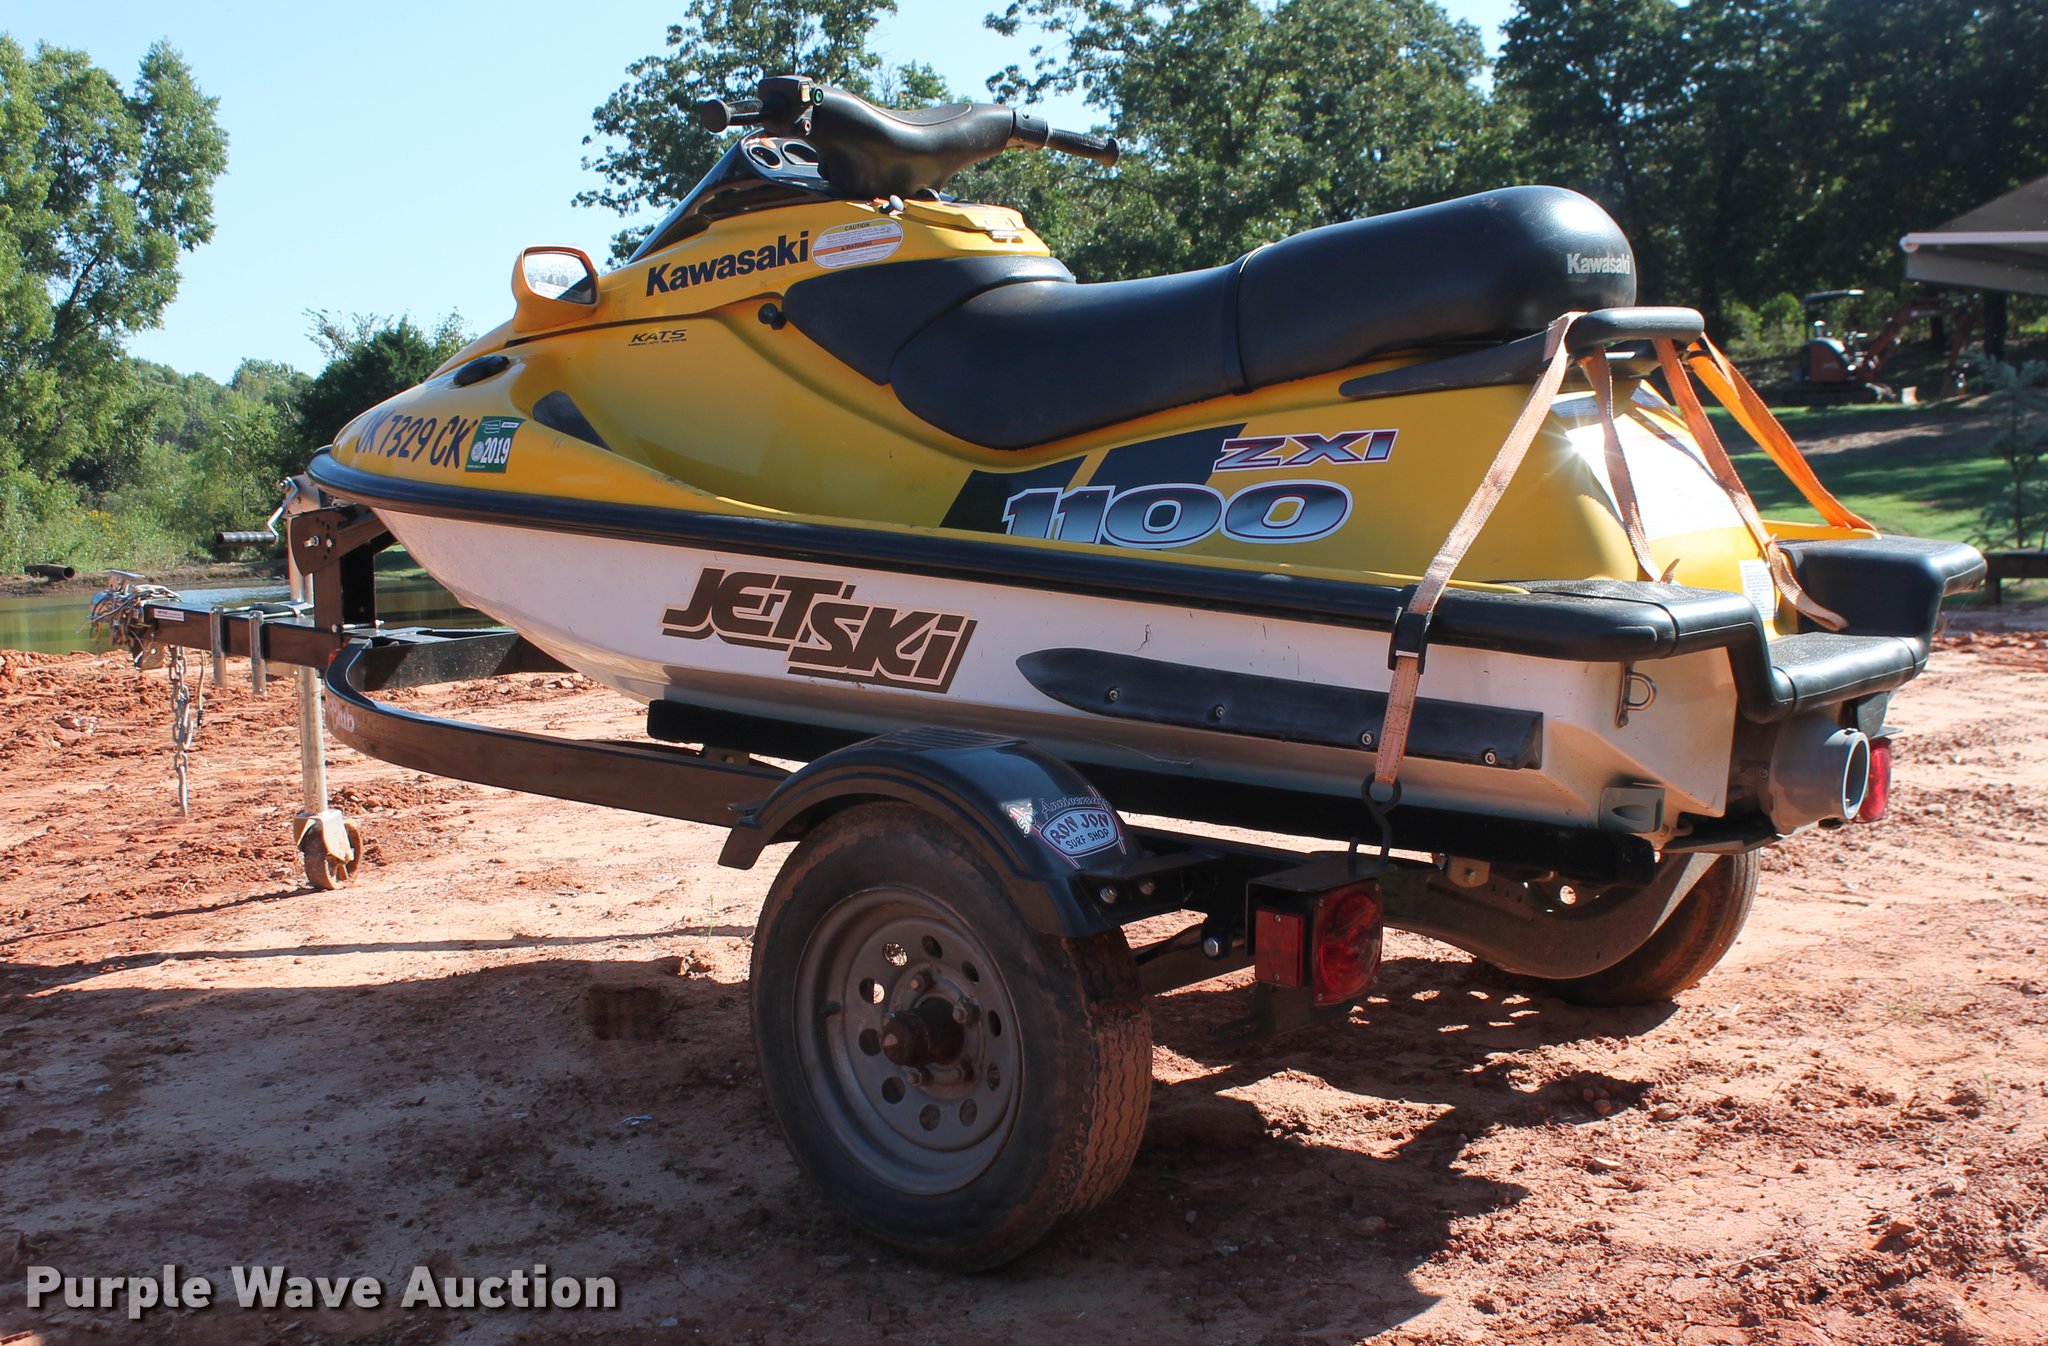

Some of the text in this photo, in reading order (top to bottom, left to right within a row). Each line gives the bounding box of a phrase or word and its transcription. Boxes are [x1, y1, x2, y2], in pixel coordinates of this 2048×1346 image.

[844, 222, 870, 231] CAUTION
[845, 241, 873, 250] WARNING
[646, 230, 809, 297] Kawasaki
[1566, 252, 1631, 275] Kawasaki
[631, 329, 688, 343] KATS
[378, 414, 438, 462] 7329
[429, 415, 479, 469] CK
[480, 437, 511, 464] 2019
[1212, 428, 1400, 473] ZXI
[1001, 479, 1354, 550] 1100
[1050, 813, 1110, 845] RON JON
[1065, 828, 1110, 849] SURF SHOP
